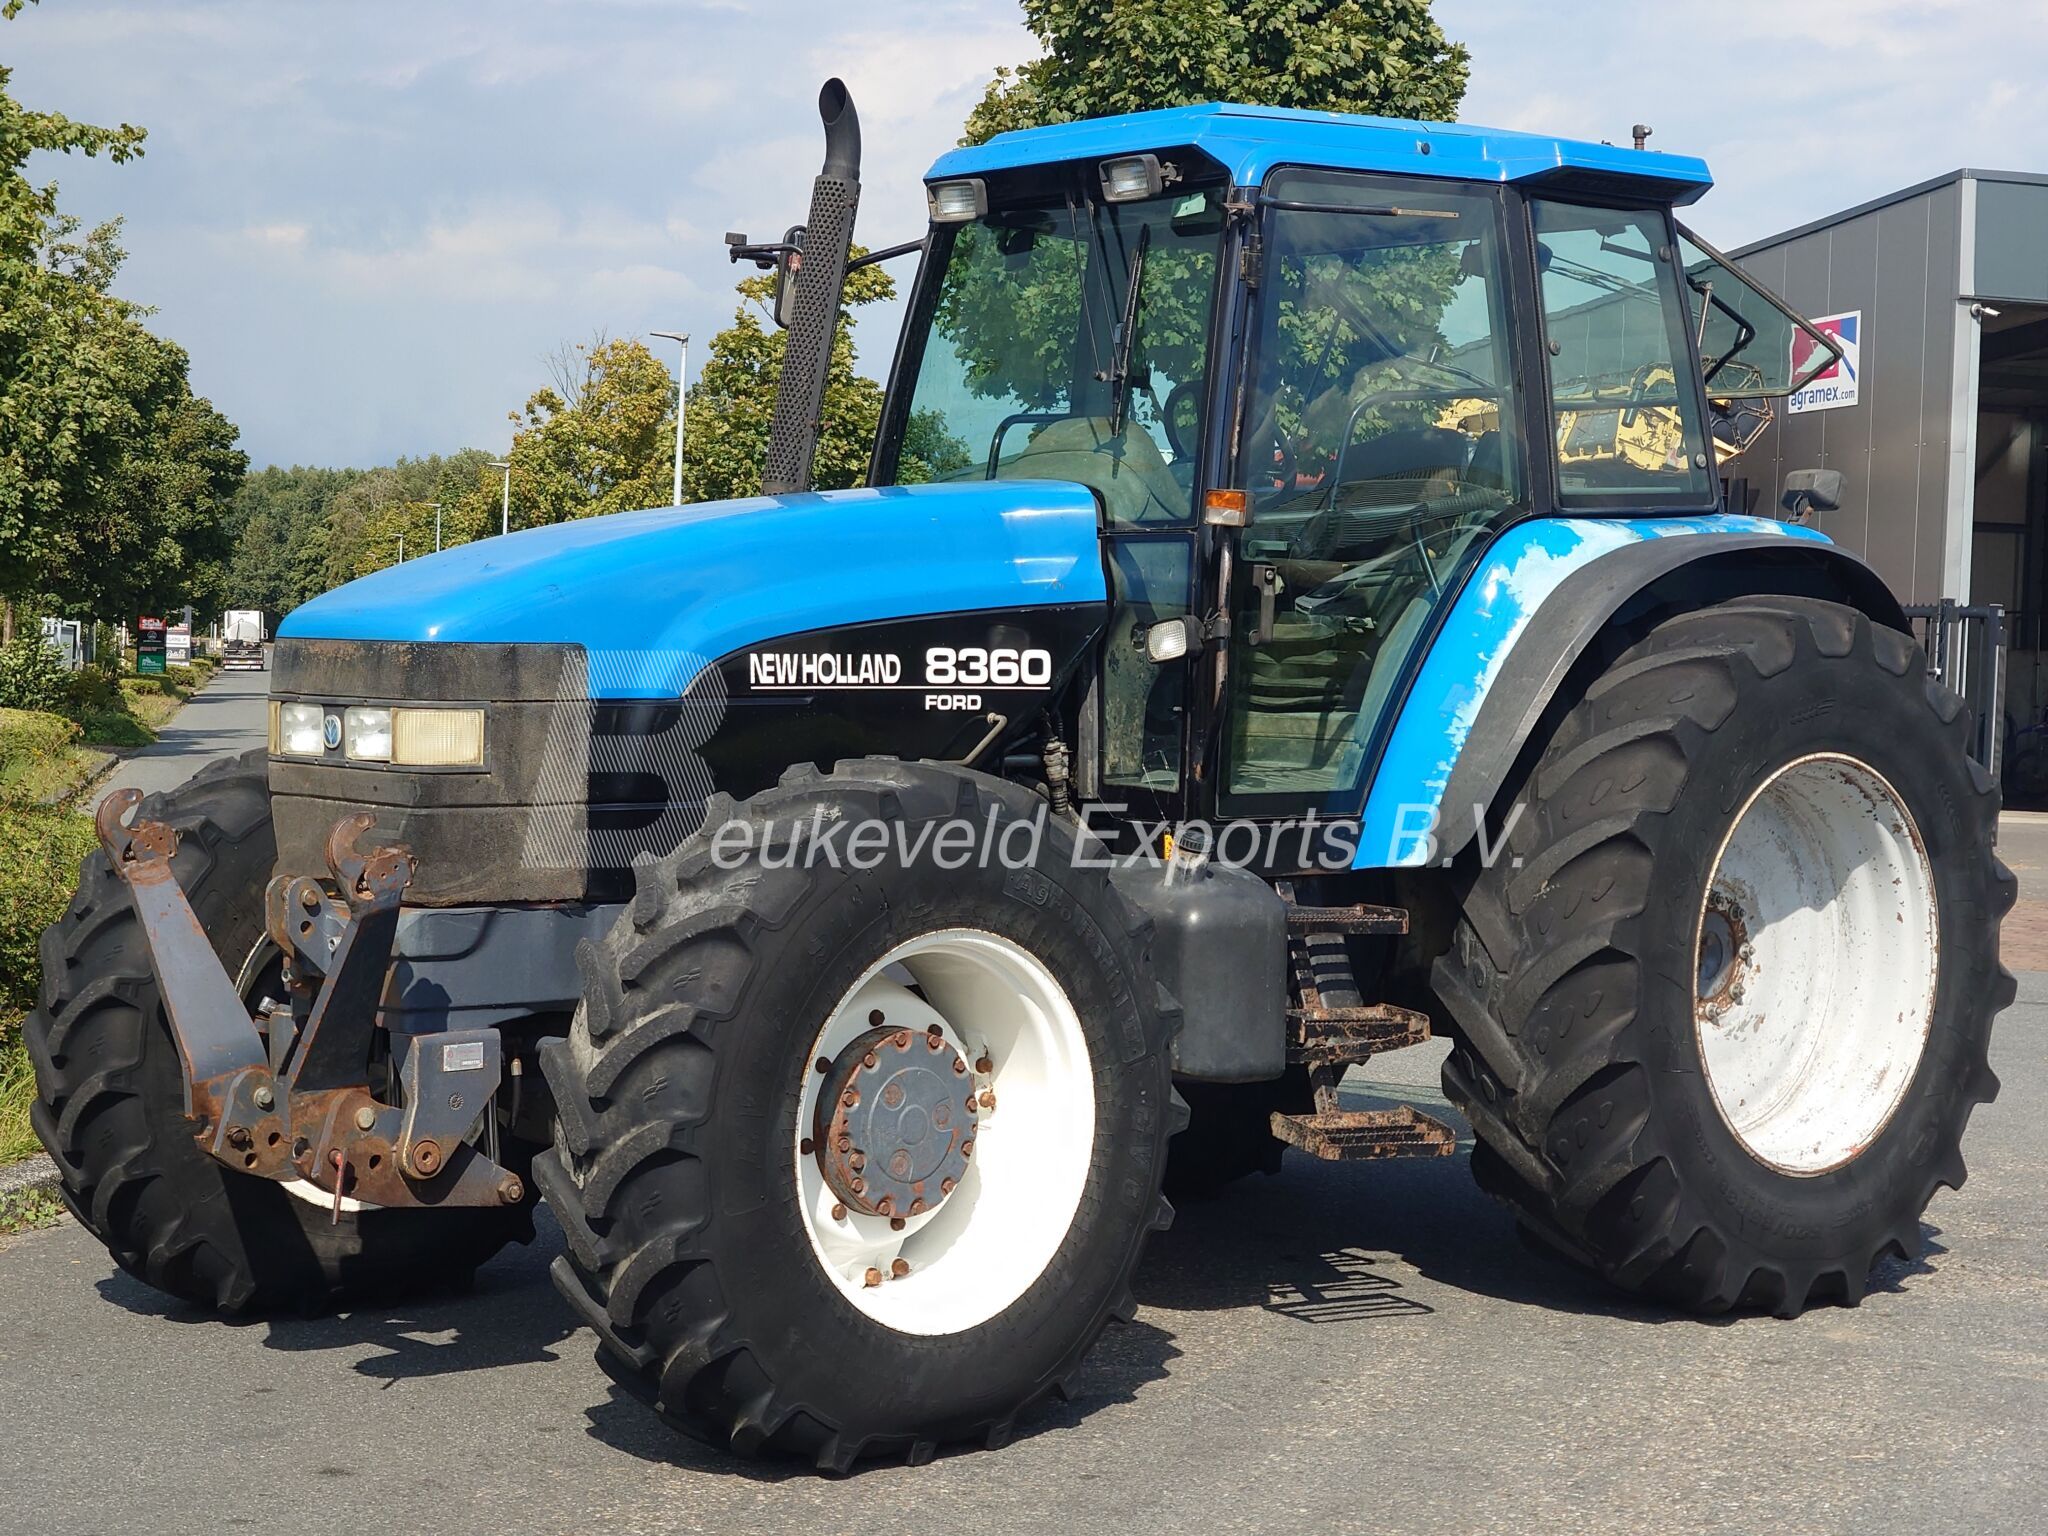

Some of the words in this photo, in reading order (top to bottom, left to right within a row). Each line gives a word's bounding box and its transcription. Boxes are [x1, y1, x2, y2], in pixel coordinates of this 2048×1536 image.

[1790, 386, 1855, 410] agramex.com
[750, 653, 798, 684] NEW
[802, 653, 901, 684] HOLLAND
[926, 647, 1052, 684] 8360
[926, 694, 982, 710] FORD
